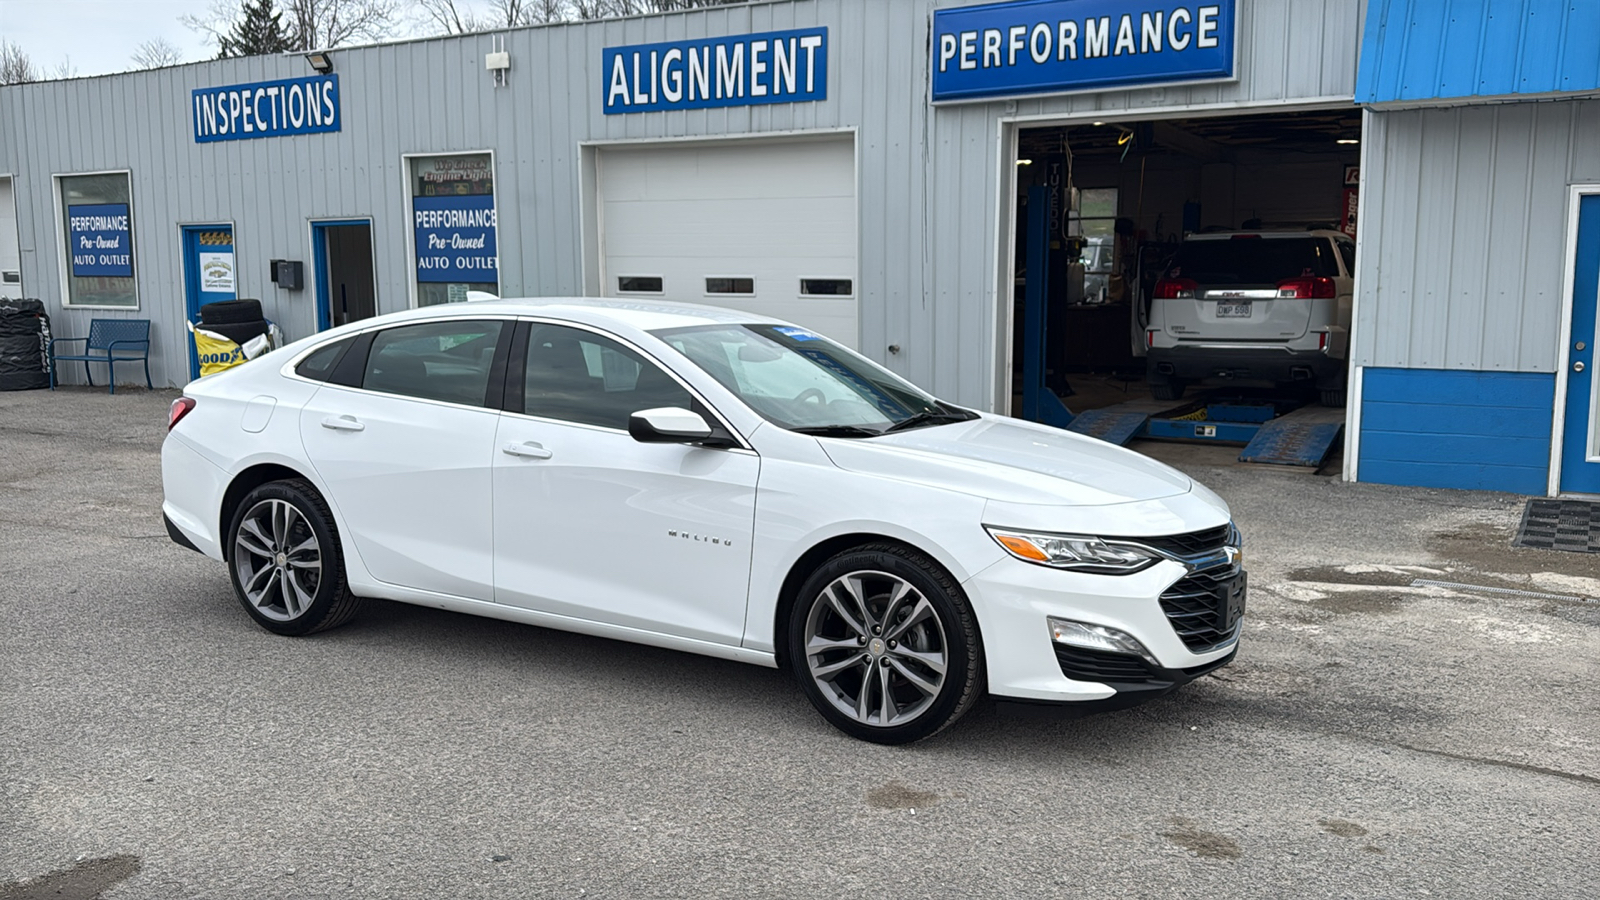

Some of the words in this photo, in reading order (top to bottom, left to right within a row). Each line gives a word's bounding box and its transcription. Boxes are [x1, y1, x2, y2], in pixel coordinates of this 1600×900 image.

[940, 6, 1219, 72] PERFORMANCE
[607, 35, 822, 107] ALIGNMENT
[195, 80, 335, 137] INSPECTIONS
[424, 171, 461, 183] Engine
[1050, 163, 1060, 231] TUXEDO
[70, 215, 128, 231] PERFORMANCE
[416, 209, 497, 228] PERFORMANCE
[80, 235, 119, 249] Pre-Owned
[428, 233, 486, 249] Pre-Owned
[74, 254, 96, 265] AUTO
[99, 254, 130, 265] OUTLET
[418, 256, 449, 269] AUTO
[455, 256, 498, 269] OUTLET
[668, 528, 732, 547] MALIBU
